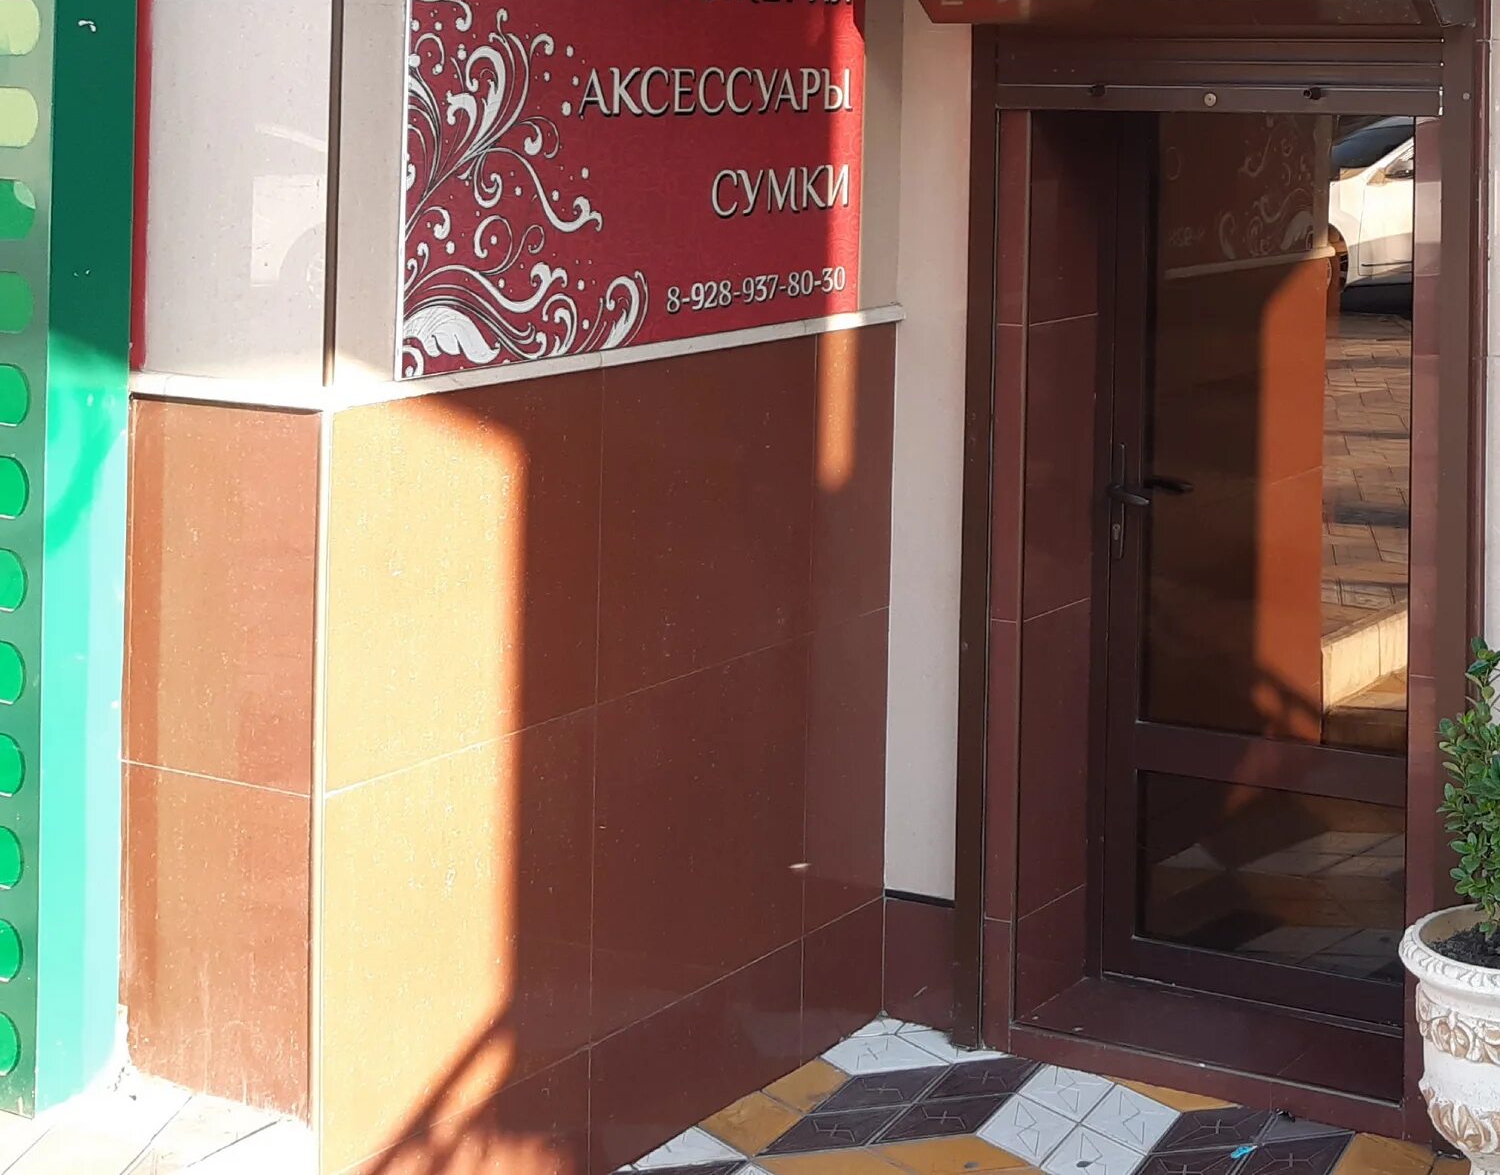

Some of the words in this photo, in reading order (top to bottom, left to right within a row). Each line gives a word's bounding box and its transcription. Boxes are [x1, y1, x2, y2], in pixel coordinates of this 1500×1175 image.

[580, 66, 853, 117] АКСЕССУАРЫ
[711, 164, 850, 217] СУМКИ
[667, 265, 846, 314] 8-928-937-80-30
